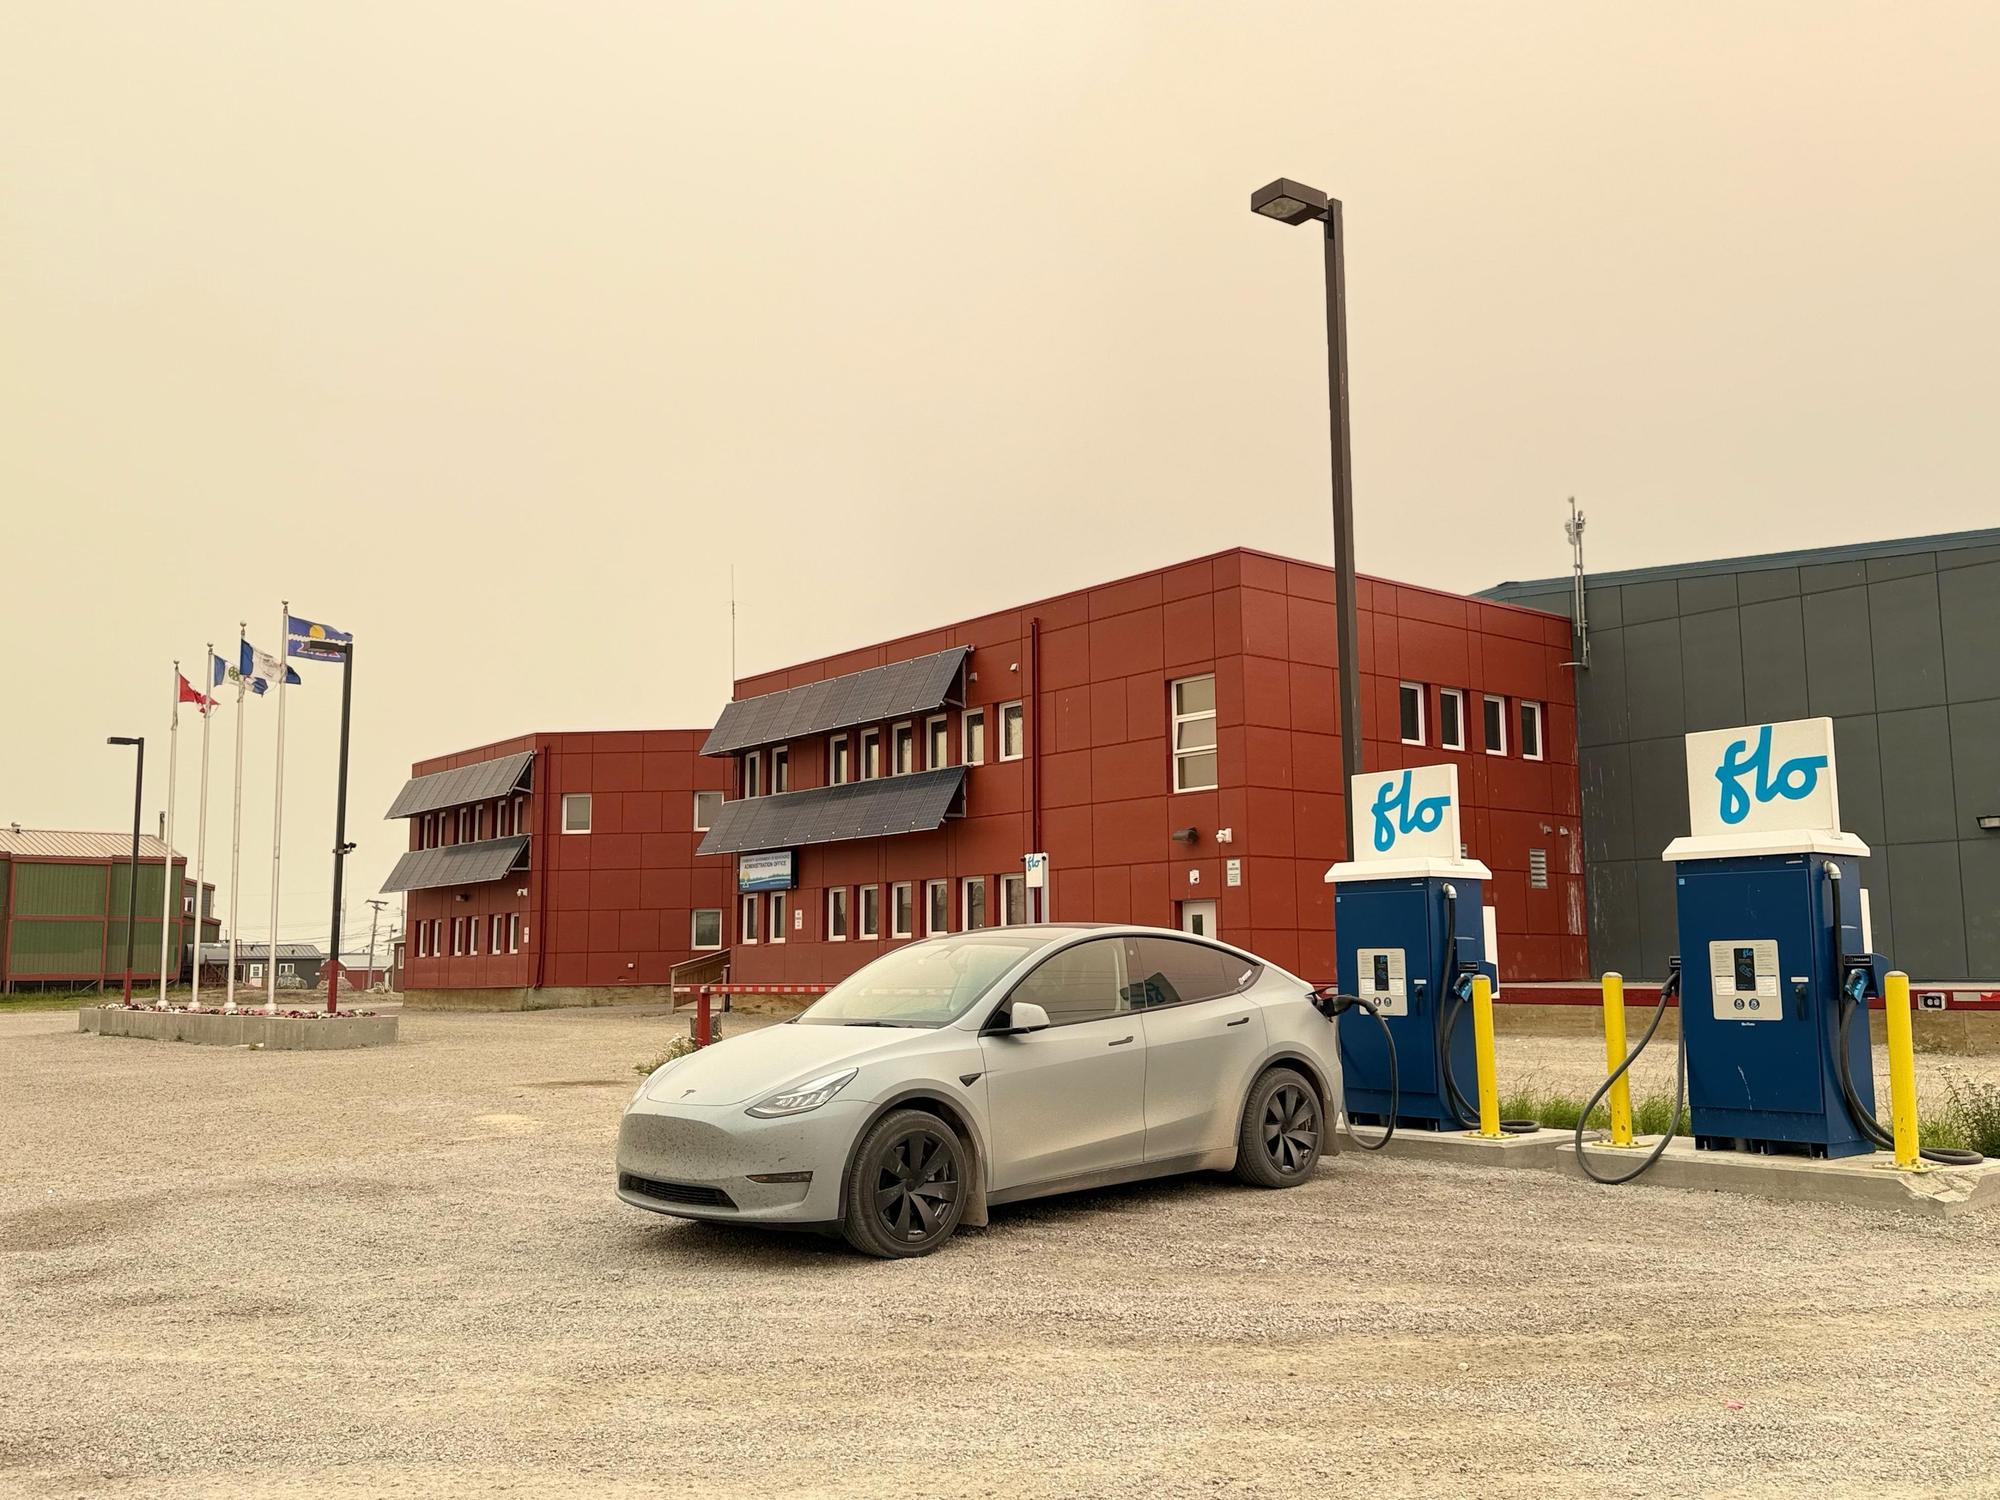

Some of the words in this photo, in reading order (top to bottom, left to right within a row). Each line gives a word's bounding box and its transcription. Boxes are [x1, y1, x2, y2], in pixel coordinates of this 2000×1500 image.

[1371, 770, 1450, 852] flo
[1714, 725, 1828, 824] flo
[1027, 855, 1041, 871] flo
